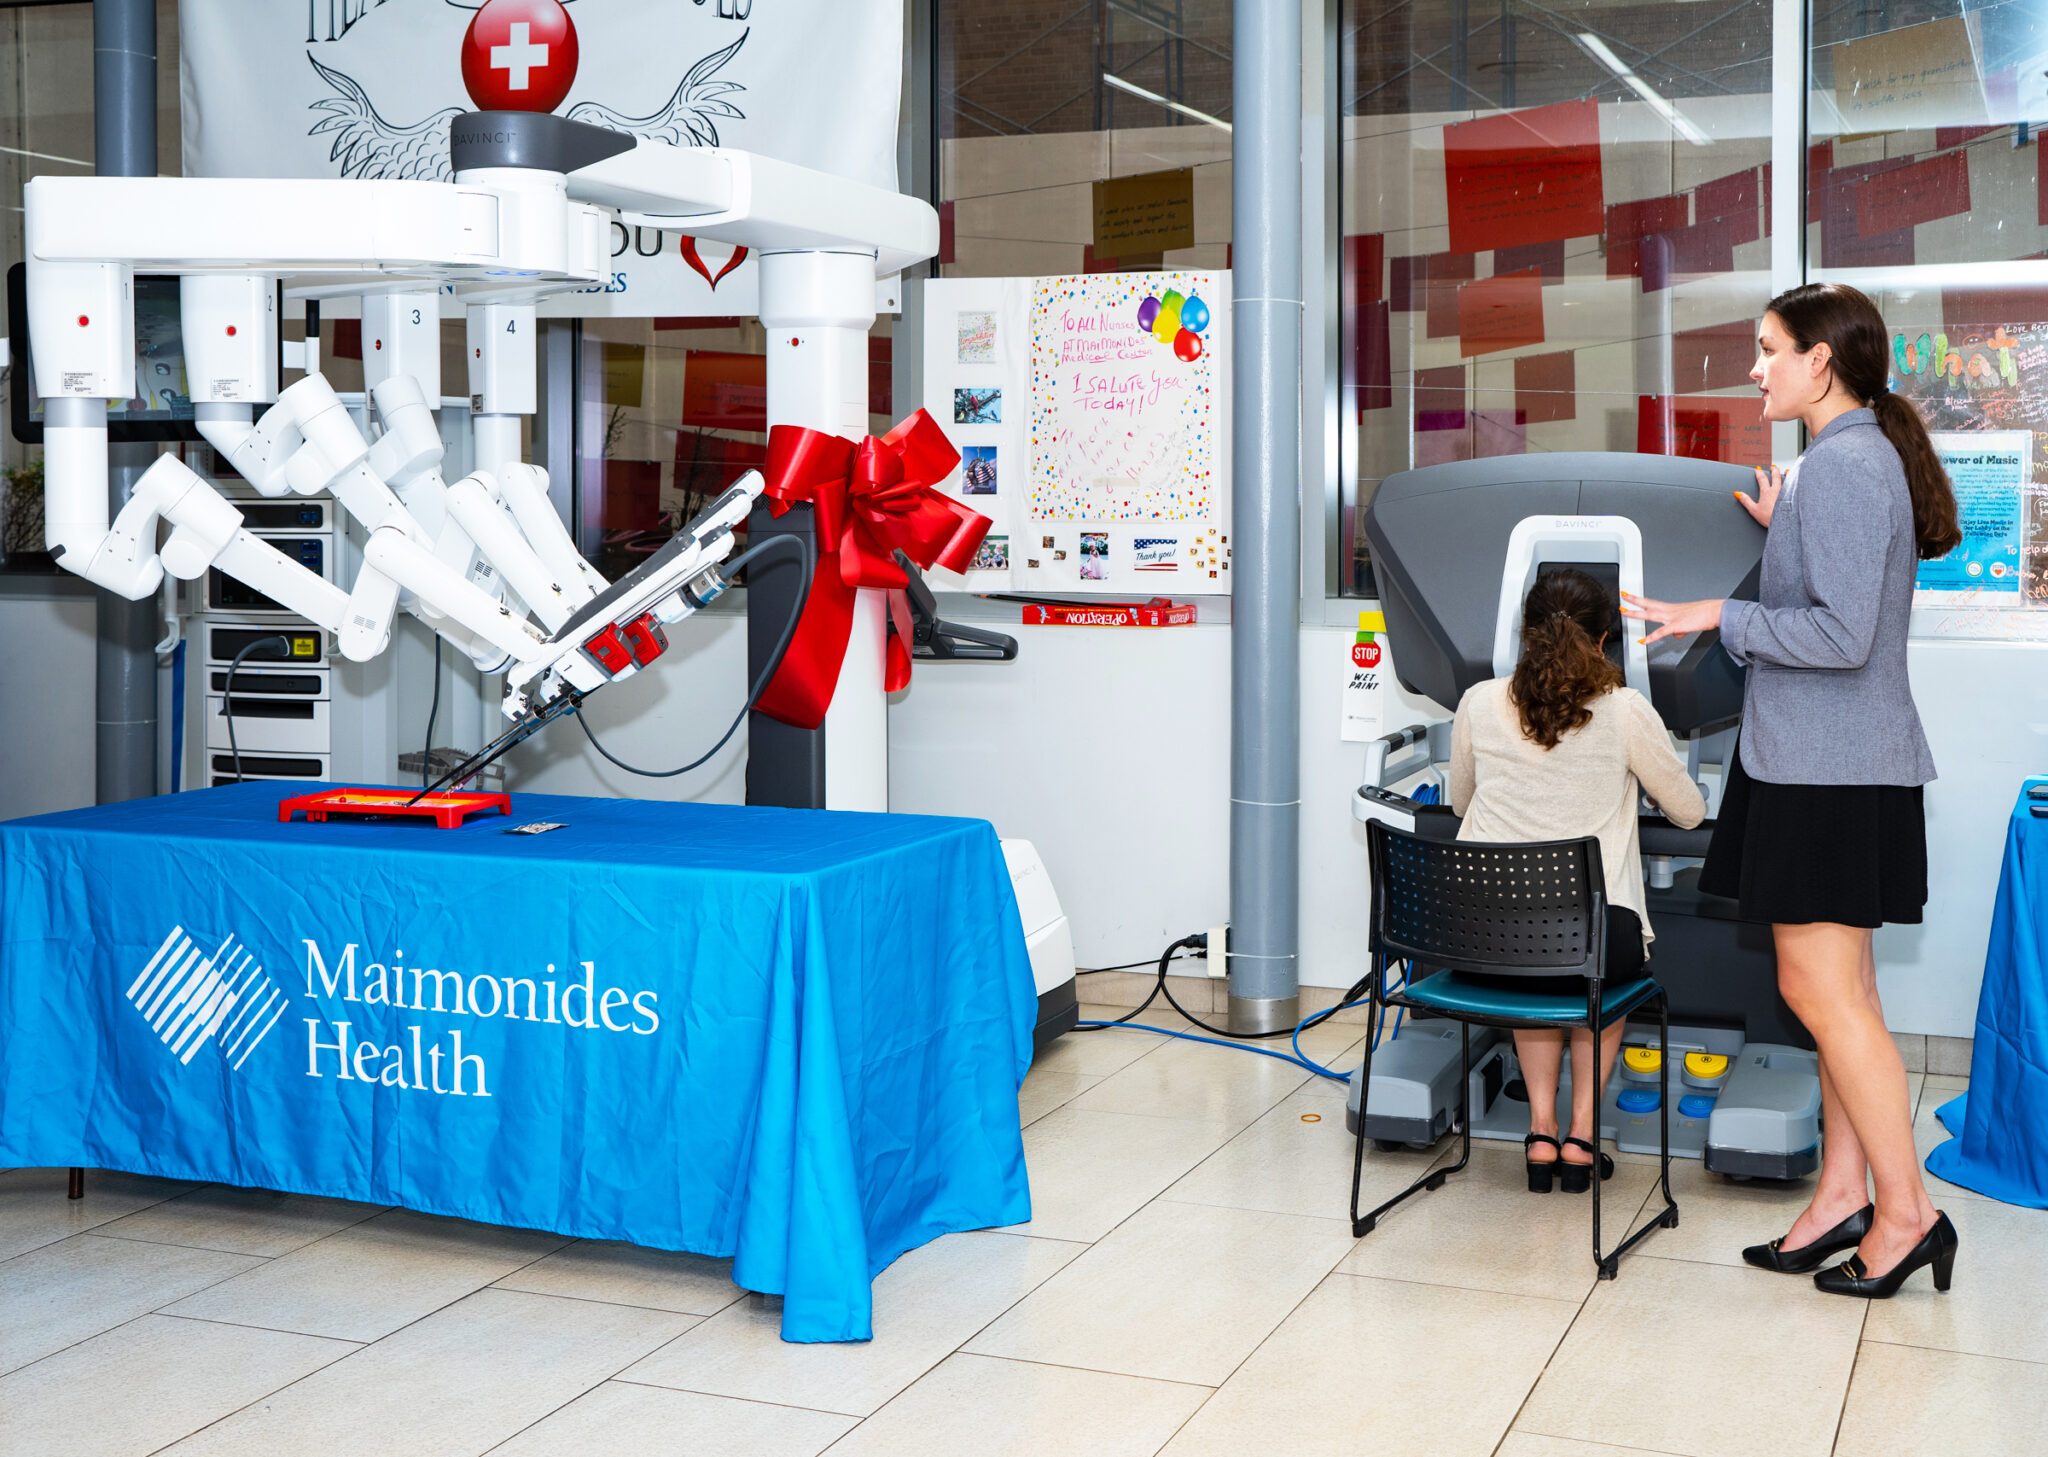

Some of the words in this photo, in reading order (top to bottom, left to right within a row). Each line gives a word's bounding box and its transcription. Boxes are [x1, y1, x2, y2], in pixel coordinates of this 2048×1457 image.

[1863, 79, 1881, 89] wish
[1886, 73, 1897, 83] for
[1902, 71, 1916, 85] my
[412, 309, 421, 325] 3
[1077, 314, 1096, 333] ALL
[1099, 312, 1136, 333] Nurses
[506, 319, 516, 335] 4
[1072, 372, 1082, 394] I
[1940, 456, 1970, 465] ower
[1973, 455, 1984, 465] of
[1986, 455, 2018, 465] Music
[1555, 520, 1599, 528] DAVINCI
[1136, 551, 1158, 562] Thank
[1158, 549, 1176, 562] you!
[2004, 544, 2017, 555] To
[2021, 544, 2040, 556] help
[1066, 612, 1128, 625] OPERATION
[1354, 647, 1379, 660] STOP
[1354, 673, 1376, 682] WET
[1348, 682, 1379, 691] PAINT
[302, 938, 660, 1035] Maimonides
[302, 1018, 492, 1097] Health
